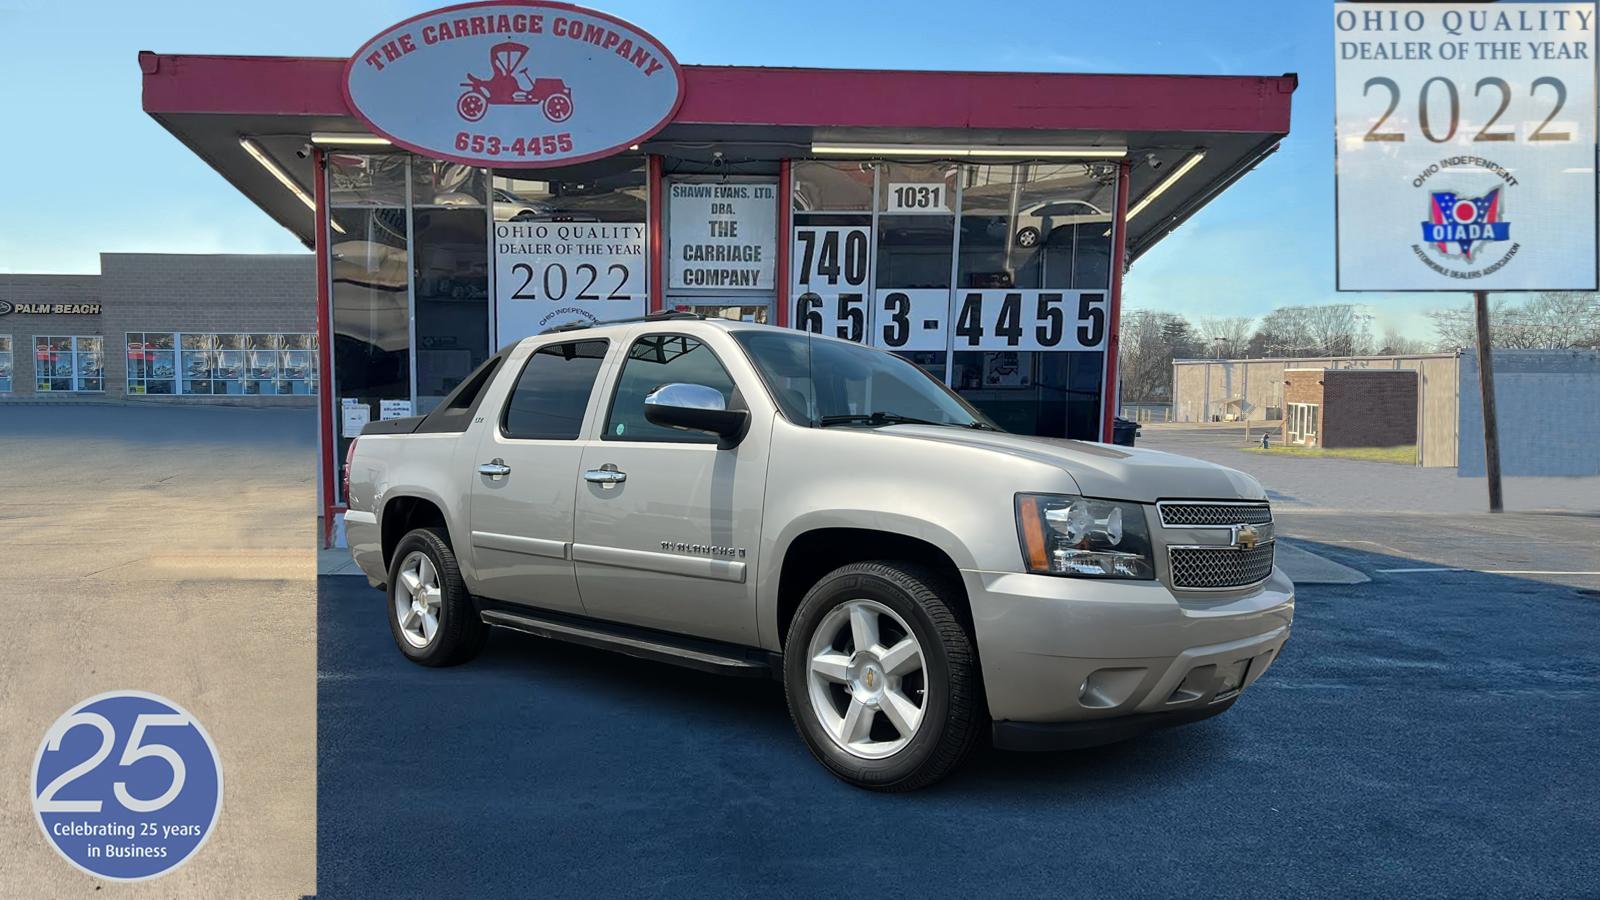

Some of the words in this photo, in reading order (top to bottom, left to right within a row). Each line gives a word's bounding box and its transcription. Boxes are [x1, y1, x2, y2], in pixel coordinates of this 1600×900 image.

[1337, 10, 1425, 31] OHIO
[1442, 10, 1592, 36] QUALITY
[366, 33, 416, 71] THE
[422, 15, 543, 45] CARRIAGE
[552, 17, 664, 77] COMPANY
[1340, 42, 1433, 60] DEALER
[1439, 42, 1469, 60] OF
[1475, 42, 1522, 60] THE
[1528, 42, 1589, 60] YEAR
[1363, 76, 1570, 143] 2022
[455, 132, 573, 155] 653-4455
[1412, 163, 1440, 188] OHIO
[1440, 155, 1519, 187] INDEPENDENT
[672, 186, 712, 198] SHAWN
[754, 187, 774, 199] LTD.
[894, 186, 939, 208] 1031
[711, 203, 736, 215] DBA.
[497, 226, 548, 239] OHIO
[557, 226, 644, 240] QUALITY
[708, 220, 738, 238] THE
[1432, 225, 1495, 240] OIADA
[499, 243, 552, 255] DEALER
[555, 243, 573, 255] OF
[576, 244, 604, 255] THE
[607, 244, 642, 255] YEAR
[683, 244, 762, 262] CARRIAGE
[799, 230, 868, 286] 740
[511, 263, 632, 301] 2022
[683, 268, 760, 286] COMPANY
[1449, 270, 1483, 280] DEALERS
[14, 304, 51, 314] PALM
[54, 304, 101, 314] BEACH
[660, 540, 736, 557] AVALANCHE
